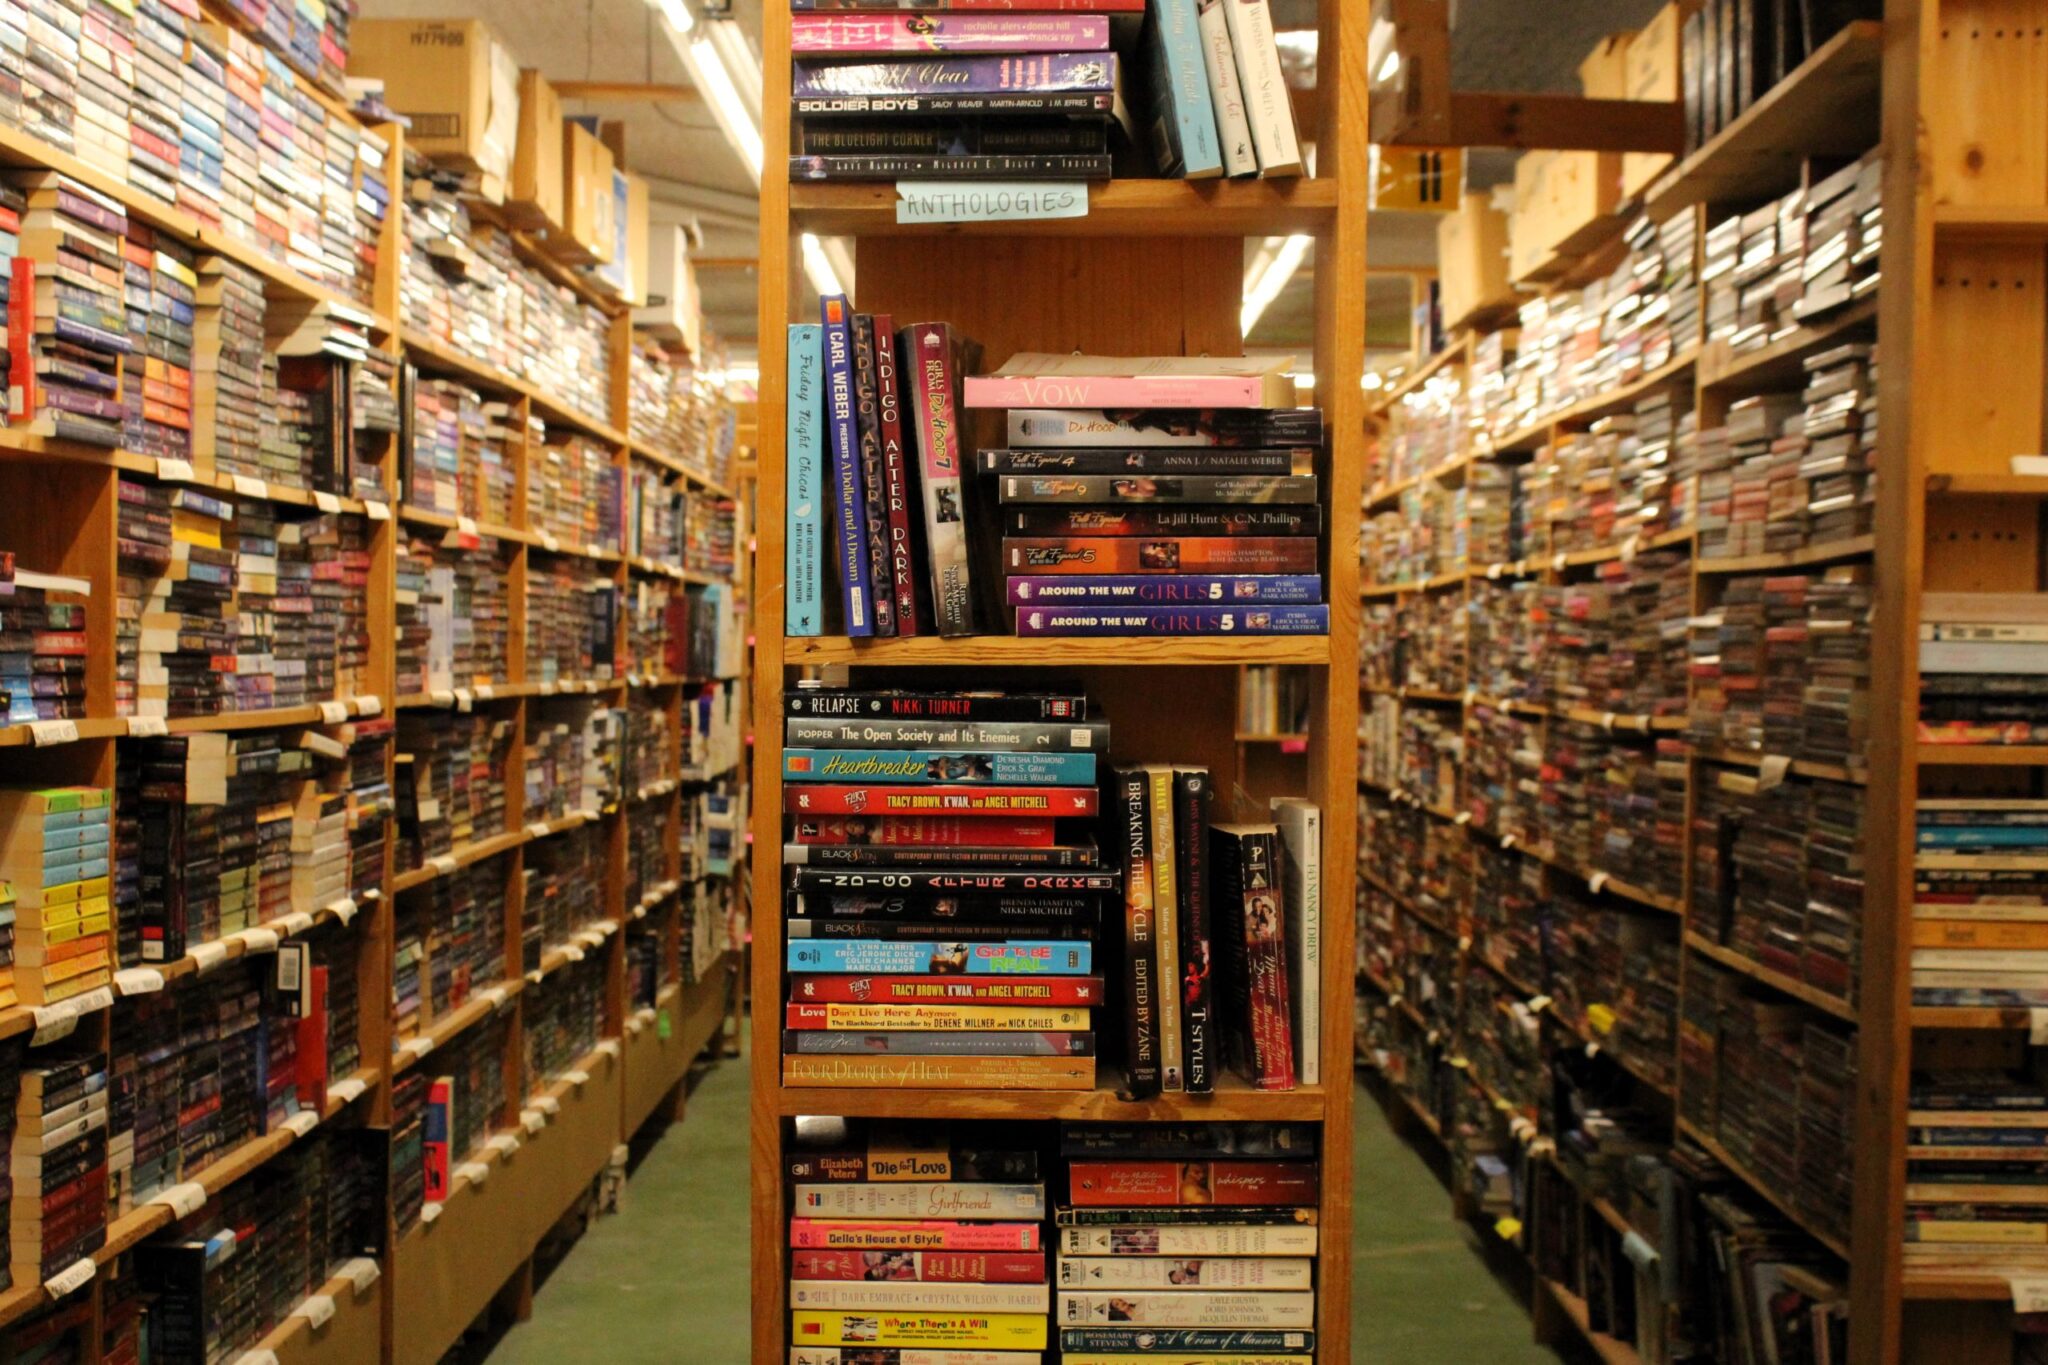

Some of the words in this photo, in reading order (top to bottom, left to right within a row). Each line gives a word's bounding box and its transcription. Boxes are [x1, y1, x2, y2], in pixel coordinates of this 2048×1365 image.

[963, 22, 998, 31] rochelle
[1000, 22, 1022, 31] alers
[1026, 22, 1053, 31] donna
[1056, 22, 1071, 31] hill
[1212, 30, 1231, 89] Balancing
[799, 99, 870, 112] SOLDIER
[871, 99, 920, 112] BOYS
[931, 101, 954, 109] SAVOY
[957, 100, 984, 108] WEAVER
[988, 99, 1043, 108] MARTIN-ARNOLD
[1063, 99, 1088, 107] JEFFRIES
[812, 132, 831, 147] THE
[834, 132, 889, 147] BLUELIGHT
[891, 131, 934, 147] CORNER
[907, 192, 1075, 217] ANTHOLOGIES
[829, 331, 845, 368] CARL
[796, 354, 814, 401] Friday
[857, 327, 874, 414] INDIGO
[879, 335, 897, 423] INDIGO
[925, 360, 936, 391] FROM
[934, 360, 945, 390] GIRLS
[833, 370, 850, 420] WEBER
[793, 410, 812, 449] Night
[840, 423, 850, 459] PRESENTS
[841, 461, 852, 470] A
[862, 431, 880, 503] AFTER
[1008, 452, 1031, 464] Full
[1030, 452, 1063, 468] Figured
[1061, 456, 1076, 468] 4
[1163, 457, 1193, 465] ANNA
[1210, 457, 1249, 466] NATALIE
[1251, 457, 1284, 466] WEBER
[799, 456, 812, 500] Chicas
[886, 439, 903, 512] AFTER
[842, 471, 858, 507] Dollar
[844, 508, 858, 532] and
[1157, 513, 1170, 524] La
[1171, 513, 1188, 527] Jill
[1190, 513, 1218, 525] Hunt
[1220, 515, 1232, 524] &
[1234, 513, 1260, 525] C.N.
[1263, 513, 1302, 527] Phillips
[847, 532, 857, 542] A
[870, 519, 885, 577] DARK
[893, 527, 909, 585] DARK
[1026, 548, 1047, 561] Full
[1048, 548, 1083, 566] Figured
[1081, 549, 1097, 563] 5
[847, 542, 859, 582] Dream
[1038, 586, 1087, 596] AROUND
[1089, 586, 1110, 596] THE
[1111, 586, 1137, 596] WAY
[1140, 584, 1207, 600] GIRLS
[1208, 582, 1223, 600] 5
[1050, 617, 1098, 627] AROUND
[1100, 617, 1121, 627] THE
[1123, 617, 1148, 627] WAY
[1151, 614, 1219, 631] GIRLS
[1219, 613, 1235, 631] 5
[811, 698, 860, 714] RELAPSE
[929, 699, 972, 715] TURNER
[797, 729, 834, 739] POPPER
[840, 727, 860, 740] The
[863, 728, 892, 744] Open
[896, 728, 934, 744] Society
[937, 729, 957, 742] and
[961, 730, 975, 743] Its
[979, 730, 1021, 744] Enemies
[1036, 735, 1050, 745] 2
[821, 754, 928, 776] Heartbreaker
[887, 796, 911, 808] TRACY
[912, 796, 943, 808] BROWN,
[944, 796, 971, 809] K'WAN,
[972, 799, 984, 808] AND
[984, 797, 1009, 809] ANGEL
[1010, 797, 1048, 809] MITCHELL
[1155, 776, 1166, 811] WHAT
[1128, 782, 1145, 858] BREAKING
[819, 876, 912, 888] INDIGO
[928, 877, 1006, 888] AFTER
[1024, 877, 1085, 888] DARK
[1131, 861, 1145, 890] THE
[1158, 863, 1170, 896] WANT
[1000, 907, 1073, 915] NIKKI-MICHELLE
[1306, 883, 1317, 924] NANCY
[1132, 892, 1148, 941] CYCLE
[1306, 926, 1317, 967] DREW
[844, 957, 870, 965] COLIN
[884, 964, 915, 972] MAJOR
[989, 957, 1049, 972] REAL
[890, 984, 916, 996] TRACY
[916, 984, 947, 997] BROWN,
[947, 984, 974, 998] K'WAN,
[975, 988, 987, 997] AND
[988, 985, 1012, 998] ANGEL
[1013, 985, 1051, 998] MITCHELL
[1135, 959, 1148, 1005] EDITED
[800, 1006, 826, 1017] Love
[831, 1008, 857, 1017] Don't
[859, 1008, 881, 1017] Live
[884, 1008, 911, 1018] Here
[915, 1008, 958, 1019] Anymore
[1137, 1007, 1149, 1025] BY
[1191, 1008, 1207, 1022] T
[831, 1019, 845, 1027] The
[886, 1020, 923, 1028] Bestseller
[923, 1021, 932, 1030] by
[933, 1018, 962, 1028] DENENE
[964, 1018, 995, 1028] MILLNER
[1008, 1018, 1026, 1028] NICK
[1028, 1018, 1054, 1029] CHILES
[1138, 1026, 1151, 1061] ZANE
[1191, 1024, 1204, 1085] STYLES
[792, 1060, 834, 1082] FOUR
[834, 1059, 897, 1083] DEGREES
[911, 1061, 953, 1081] HEAT
[820, 1158, 864, 1169] Elizabeth
[871, 1161, 898, 1175] Die
[899, 1160, 912, 1171] for
[909, 1157, 947, 1175] Love
[828, 1169, 858, 1180] Peters
[1217, 1173, 1266, 1189] whispers
[927, 1184, 992, 1216] Girlfriends
[829, 1234, 863, 1244] Della's
[865, 1234, 897, 1244] House
[899, 1234, 911, 1244] of
[913, 1233, 943, 1246] Style
[841, 1292, 867, 1303] DARK
[868, 1292, 912, 1304] EMBRACE
[922, 1293, 961, 1305] CRYSTAL
[963, 1294, 999, 1305] WILSON
[1007, 1295, 1041, 1306] HARRIS
[884, 1317, 917, 1329] Where
[919, 1318, 957, 1329] There's
[959, 1319, 966, 1329] A
[969, 1318, 988, 1329] Will
[1239, 1331, 1282, 1345] Manners
